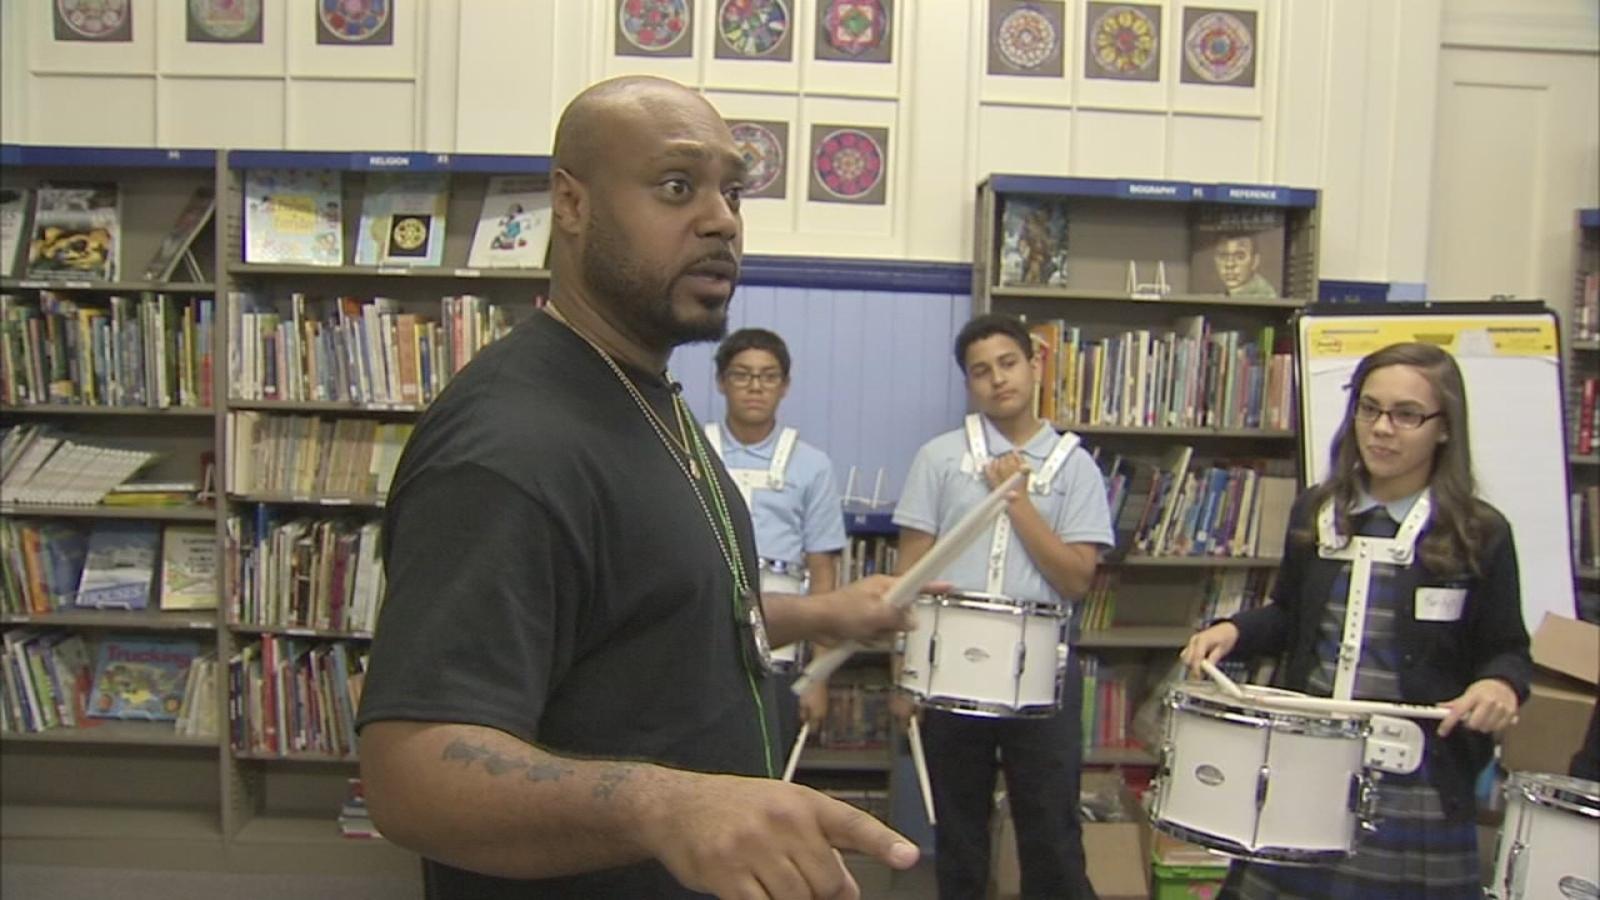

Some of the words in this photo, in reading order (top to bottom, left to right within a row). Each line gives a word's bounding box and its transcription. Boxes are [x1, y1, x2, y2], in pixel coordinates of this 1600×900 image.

[369, 156, 409, 166] RELIGION
[1129, 183, 1176, 195] BIOGRAPHY
[1229, 188, 1277, 199] REFERENCE
[107, 644, 191, 670] Trucking
